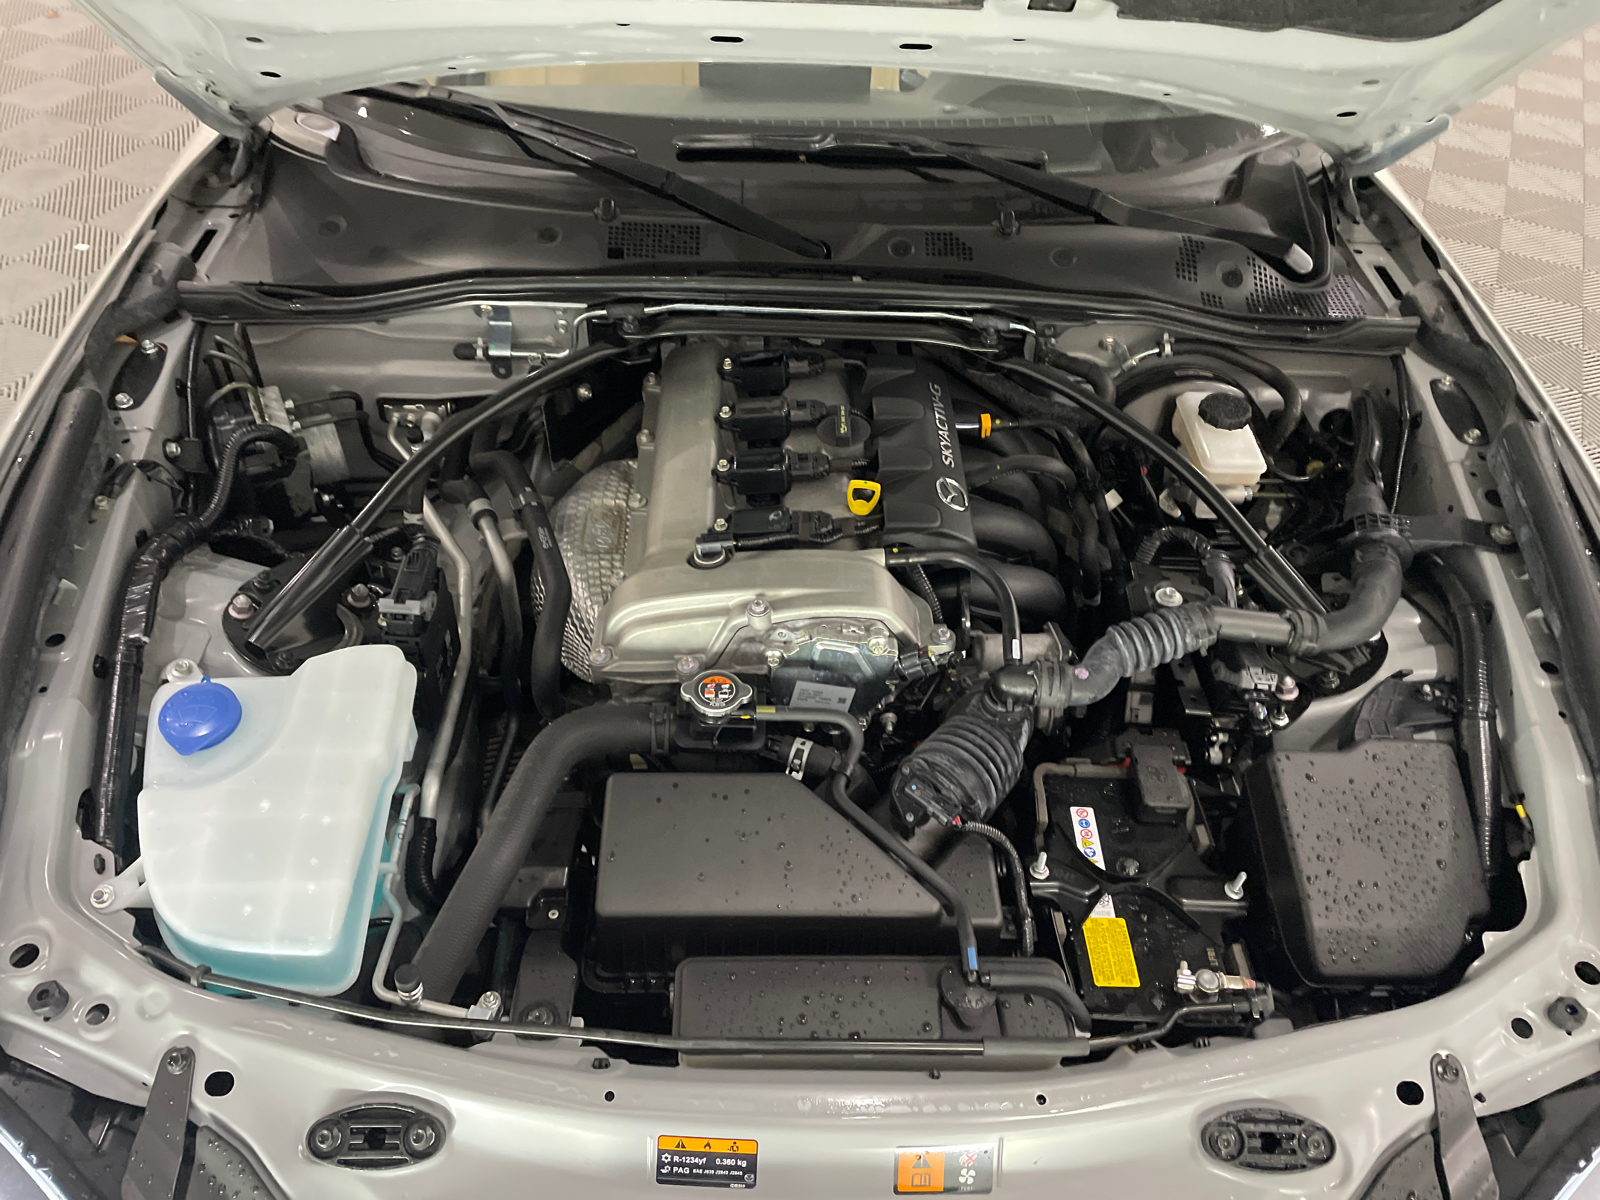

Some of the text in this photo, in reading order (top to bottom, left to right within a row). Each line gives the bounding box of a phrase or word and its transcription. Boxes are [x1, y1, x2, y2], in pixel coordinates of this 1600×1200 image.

[929, 382, 955, 468] SKYACTIV-G
[673, 1155, 707, 1165] R-1234yf
[737, 1158, 747, 1167] kg
[673, 1166, 690, 1174] PAG
